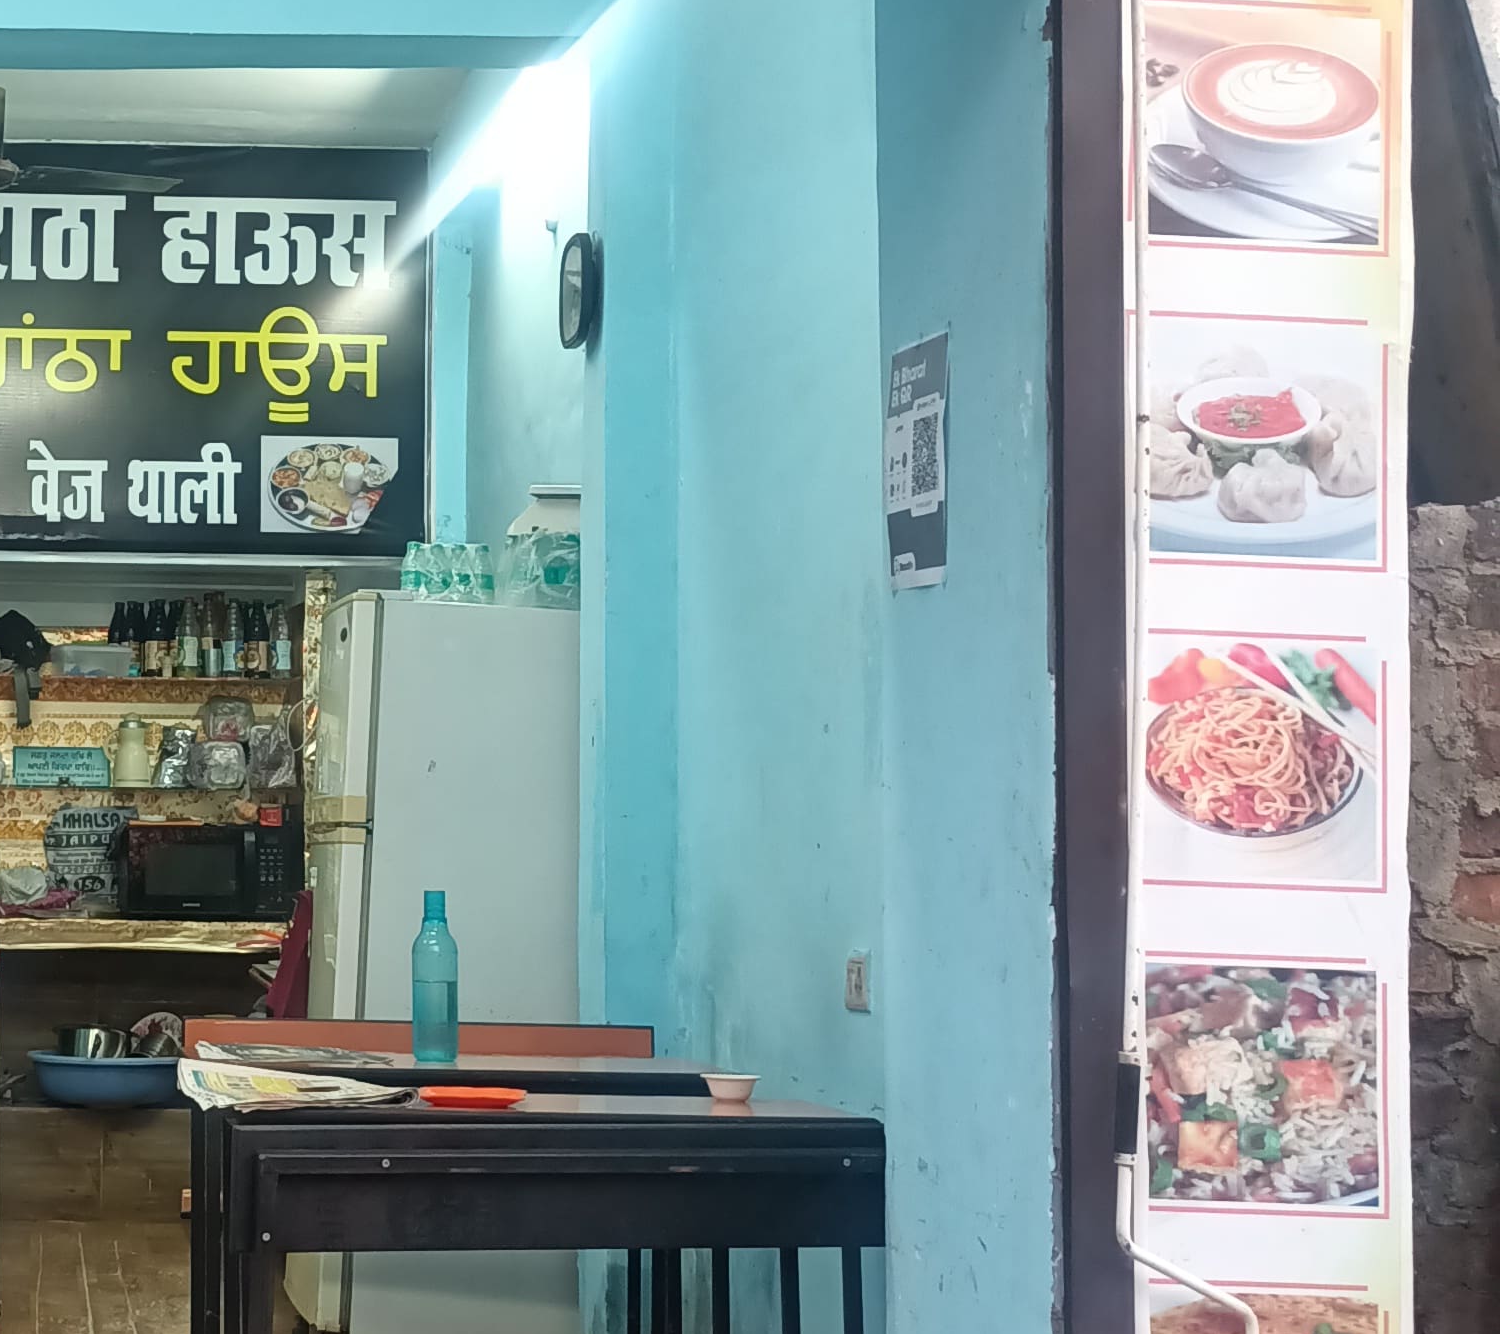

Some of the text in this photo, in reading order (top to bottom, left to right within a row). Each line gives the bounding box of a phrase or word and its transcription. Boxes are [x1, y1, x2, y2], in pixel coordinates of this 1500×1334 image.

[154, 195, 397, 290] हाऊस
[167, 306, 387, 423] ਹਾਊਸ
[27, 438, 242, 525] वेज थाली
[61, 834, 111, 847] JAIPU
[62, 812, 120, 828] KHALSA
[77, 878, 101, 890] 156
